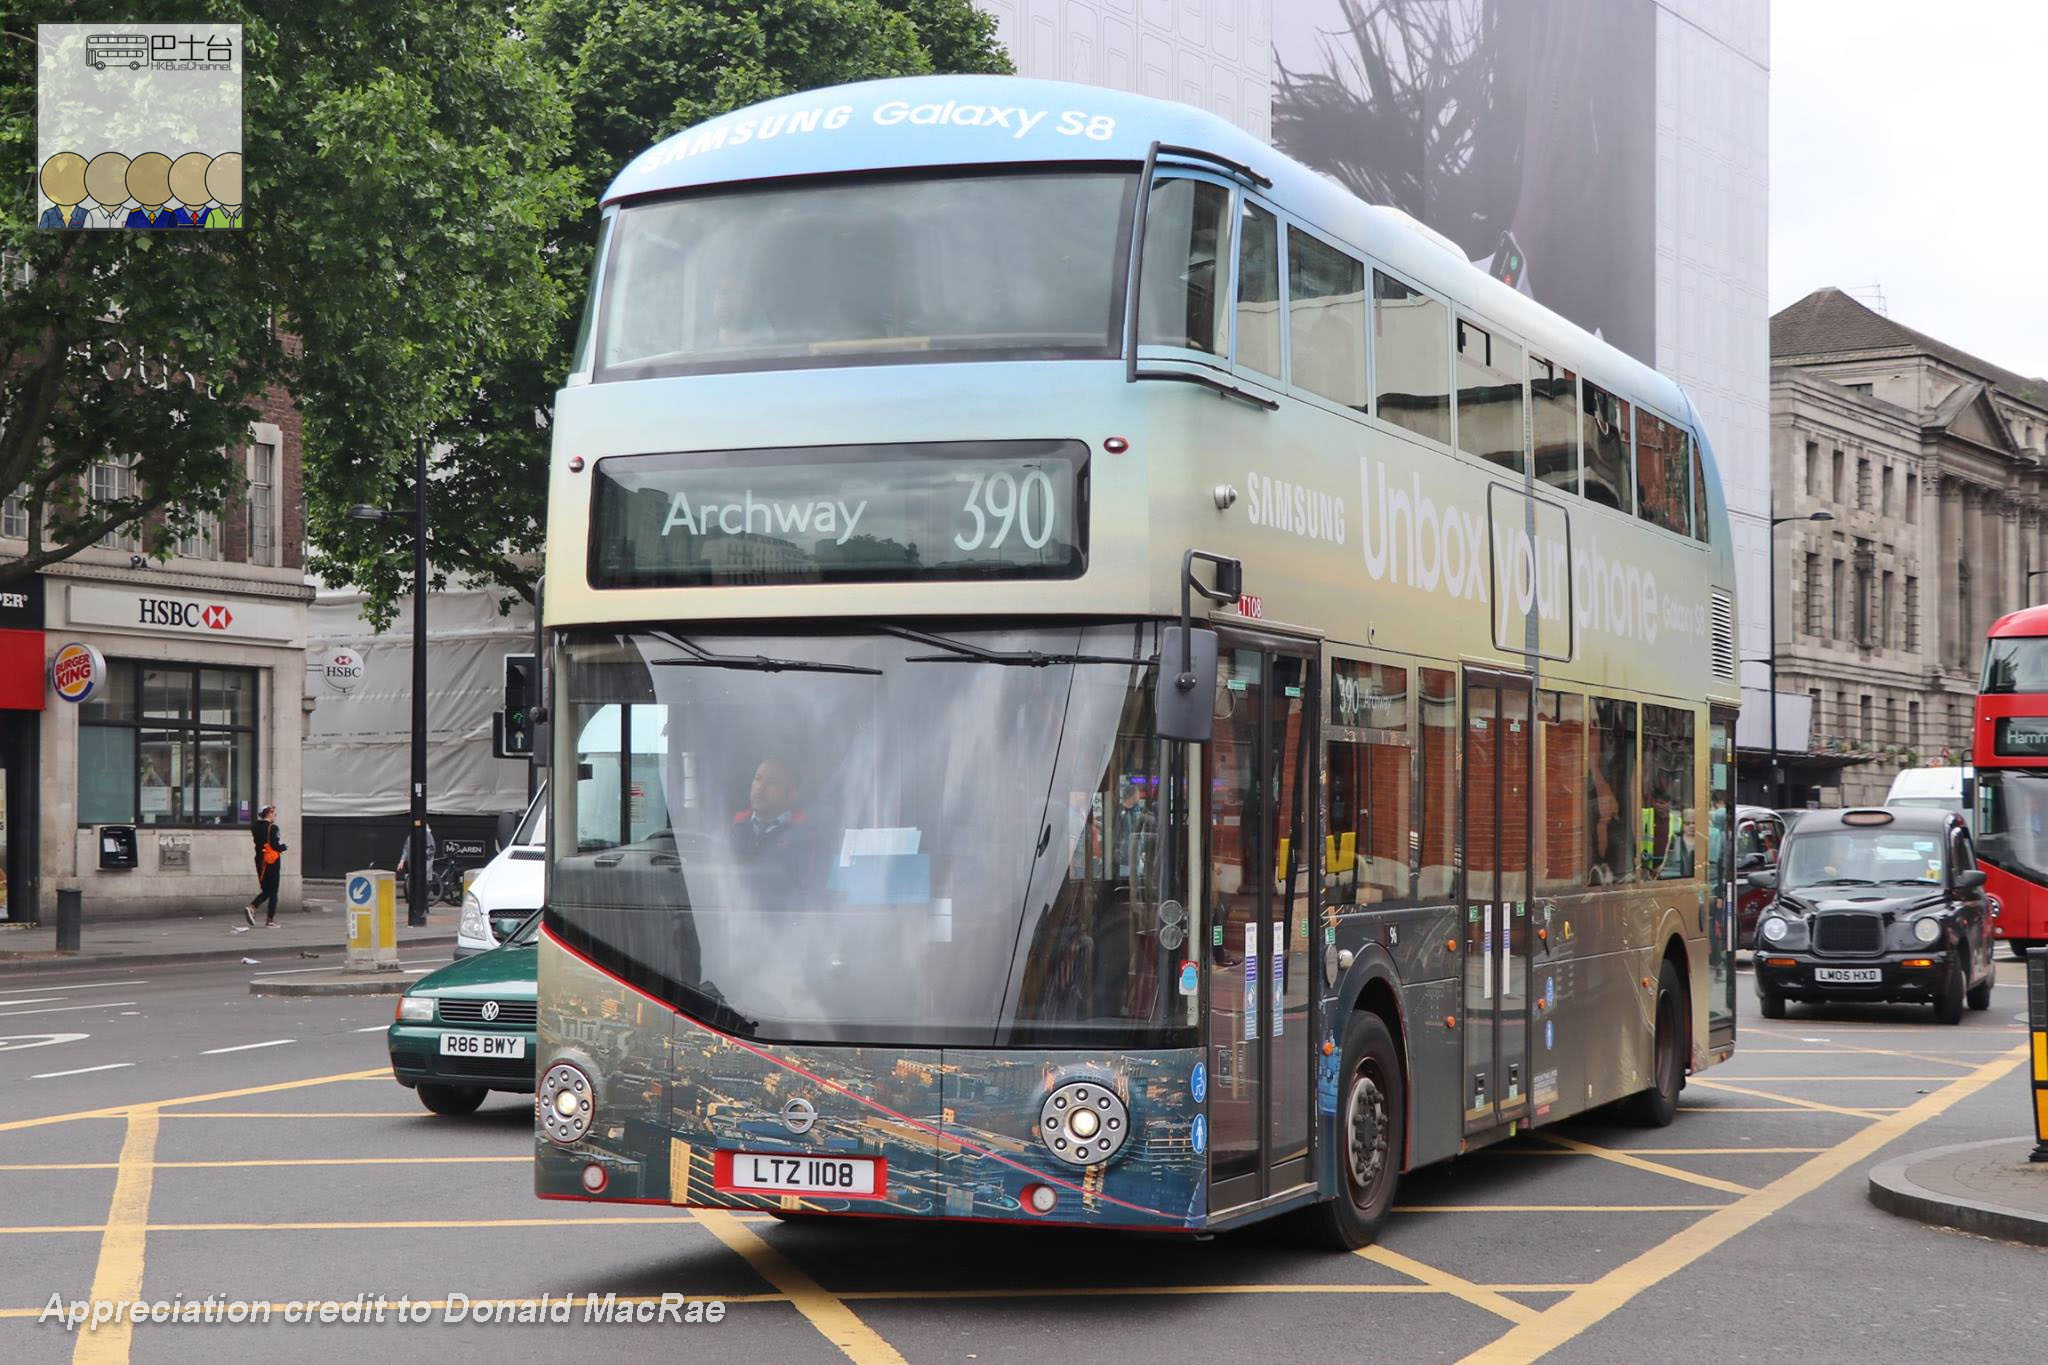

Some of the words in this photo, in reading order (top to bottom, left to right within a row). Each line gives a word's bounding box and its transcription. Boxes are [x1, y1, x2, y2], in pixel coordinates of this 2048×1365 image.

[639, 105, 854, 174] SAMSUNG
[872, 100, 1049, 140] Galaxy
[1055, 110, 1117, 141] S8
[661, 489, 868, 546] Archway
[953, 470, 1055, 551] 390
[1247, 471, 1345, 545] SAMSUNG
[1359, 455, 1488, 604] Unbox
[1492, 517, 1567, 648] your
[1573, 532, 1659, 662] phone
[138, 598, 200, 628] HSBC
[55, 652, 91, 676] BURGER
[56, 663, 92, 693] KING
[326, 666, 361, 678] HSBC
[1338, 673, 1360, 714] 390
[1853, 970, 1877, 981] HXD
[447, 1036, 478, 1053] R86
[484, 1037, 517, 1054] BWY
[754, 1158, 801, 1184] LTZ
[808, 1161, 853, 1187] 1108
